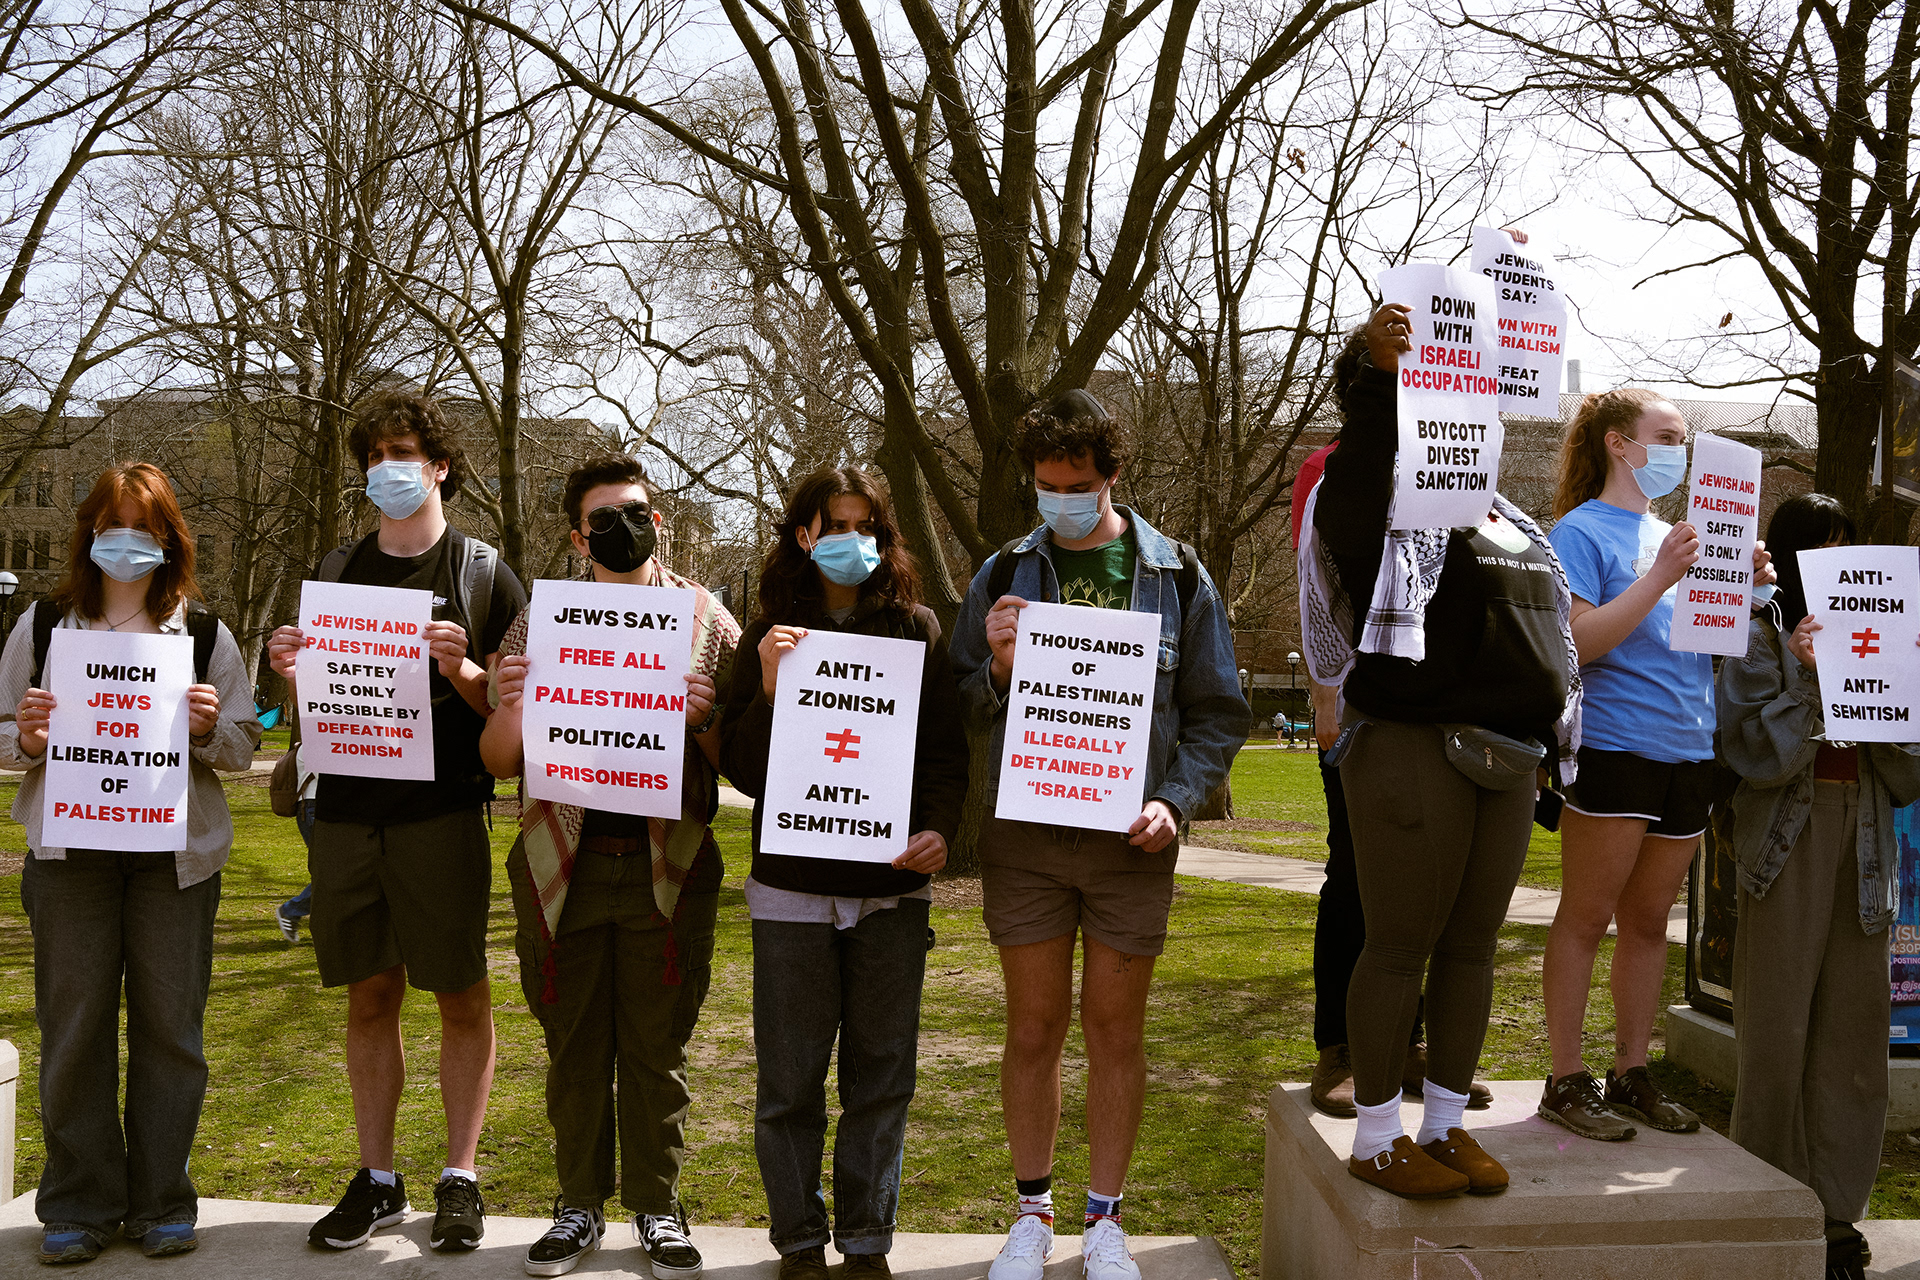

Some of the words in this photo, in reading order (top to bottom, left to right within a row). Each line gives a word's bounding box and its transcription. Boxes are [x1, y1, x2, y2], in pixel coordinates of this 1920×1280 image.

[1495, 253, 1544, 274] JEWISH
[1483, 265, 1554, 291] STUDENTS
[1502, 288, 1536, 304] SAY:
[1431, 295, 1475, 320] DOWN
[1433, 321, 1472, 344] WITH
[1498, 318, 1517, 331] WN
[1521, 321, 1557, 337] WITH
[1499, 335, 1560, 354] RIALISM
[1421, 345, 1480, 369] ISRAELI
[1402, 368, 1497, 395] OCCUPATION
[1499, 365, 1539, 381] FEAT
[1498, 382, 1539, 398] NISM
[1418, 420, 1486, 442] BOYCOTT
[1428, 446, 1479, 466] DIVEST
[1416, 471, 1488, 490] SANCTION
[1699, 473, 1738, 491] JEWISH
[1739, 480, 1754, 494] AND
[1694, 496, 1755, 517] PALESTINIAN
[1707, 521, 1744, 538] SAFTEY
[1705, 544, 1714, 557] IS
[1717, 546, 1741, 560] ONLY
[1476, 556, 1496, 565] THIS
[1498, 557, 1506, 566] IS
[1506, 559, 1520, 569] NOT
[1521, 562, 1527, 571] A
[1686, 564, 1736, 583] POSSIBLE
[1738, 572, 1749, 584] BY
[1689, 590, 1743, 606] DEFEATING
[1828, 596, 1903, 613] ZIONISM
[312, 614, 377, 632] JEWISH
[381, 621, 417, 635] AND
[554, 608, 618, 626] JEWS
[624, 612, 677, 631] SAY:
[1693, 614, 1735, 628] ZIONISM
[306, 637, 420, 659] PALESTINIAN
[1030, 632, 1144, 657] THOUSANDS
[560, 648, 615, 667] FREE
[623, 652, 665, 670] ALL
[1072, 662, 1096, 676] OF
[87, 663, 156, 682] UMICH
[327, 662, 396, 678] SAFTEY
[329, 683, 346, 695] IS
[350, 685, 396, 698] ONLY
[536, 686, 684, 712] PALESTINIAN
[1018, 680, 1143, 707] PALESTINIAN
[87, 693, 151, 710] JEWS
[308, 702, 393, 718] POSSIBLE
[397, 708, 420, 720] BY
[798, 689, 895, 715] ZIONISM
[1025, 706, 1130, 730] PRISONERS
[1831, 704, 1909, 721] SEMITISM
[97, 721, 139, 738] FOR
[318, 722, 413, 738] DEFEATING
[549, 727, 665, 750] POLITICAL
[331, 743, 402, 758] ZIONISM
[1024, 731, 1126, 754] ILLEGALLY
[52, 745, 180, 767] LIBERATION
[546, 763, 668, 790] PRISONERS
[1011, 754, 1103, 776] DETAINED
[1108, 765, 1134, 780] BY
[101, 778, 128, 794] OF
[54, 802, 174, 823] PALESTINE
[776, 812, 892, 839] SEMITISM
[1890, 943, 1920, 954] 4:30P
